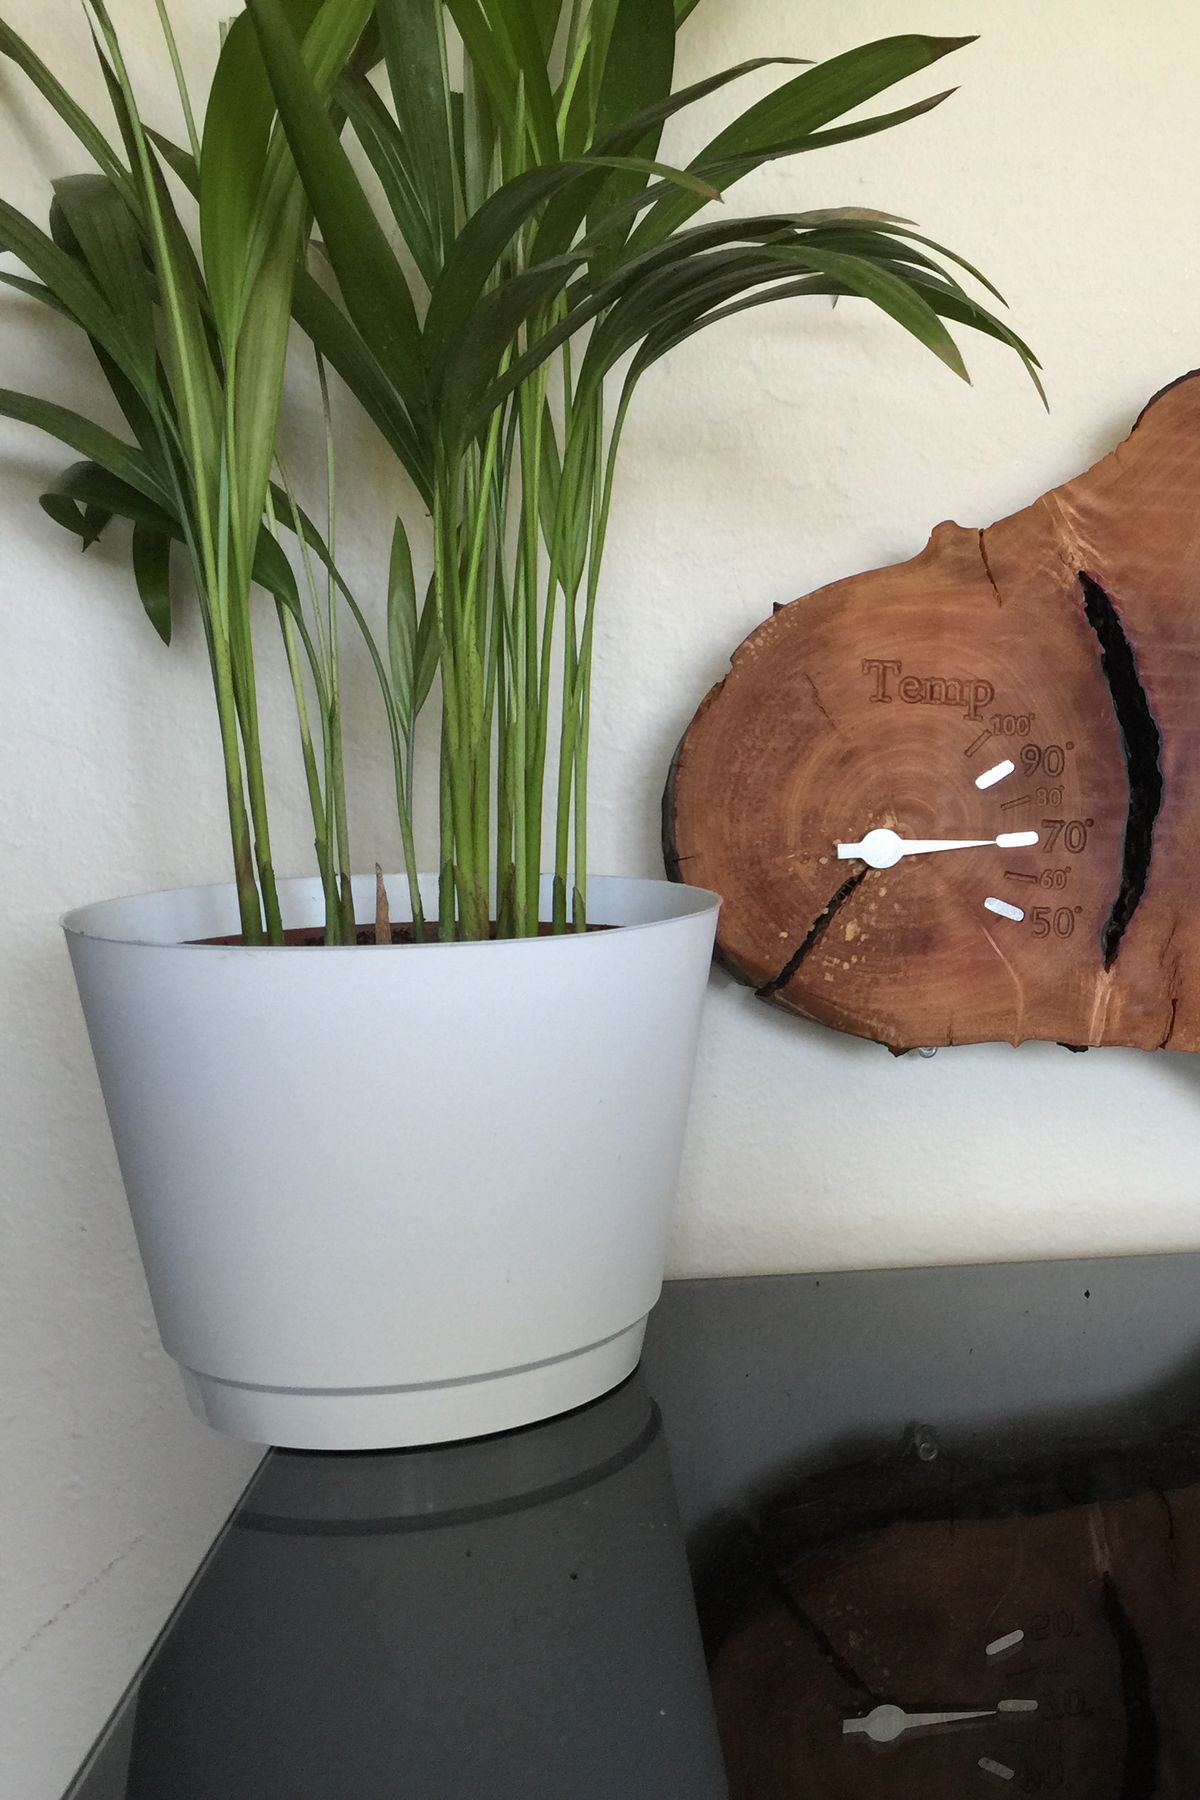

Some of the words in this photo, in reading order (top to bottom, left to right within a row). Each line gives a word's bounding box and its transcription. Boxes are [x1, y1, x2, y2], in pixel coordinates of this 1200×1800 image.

[862, 659, 996, 721] Temp
[1020, 741, 1075, 778] 90°
[1041, 818, 1095, 854] 70°
[1032, 905, 1083, 939] 50°
